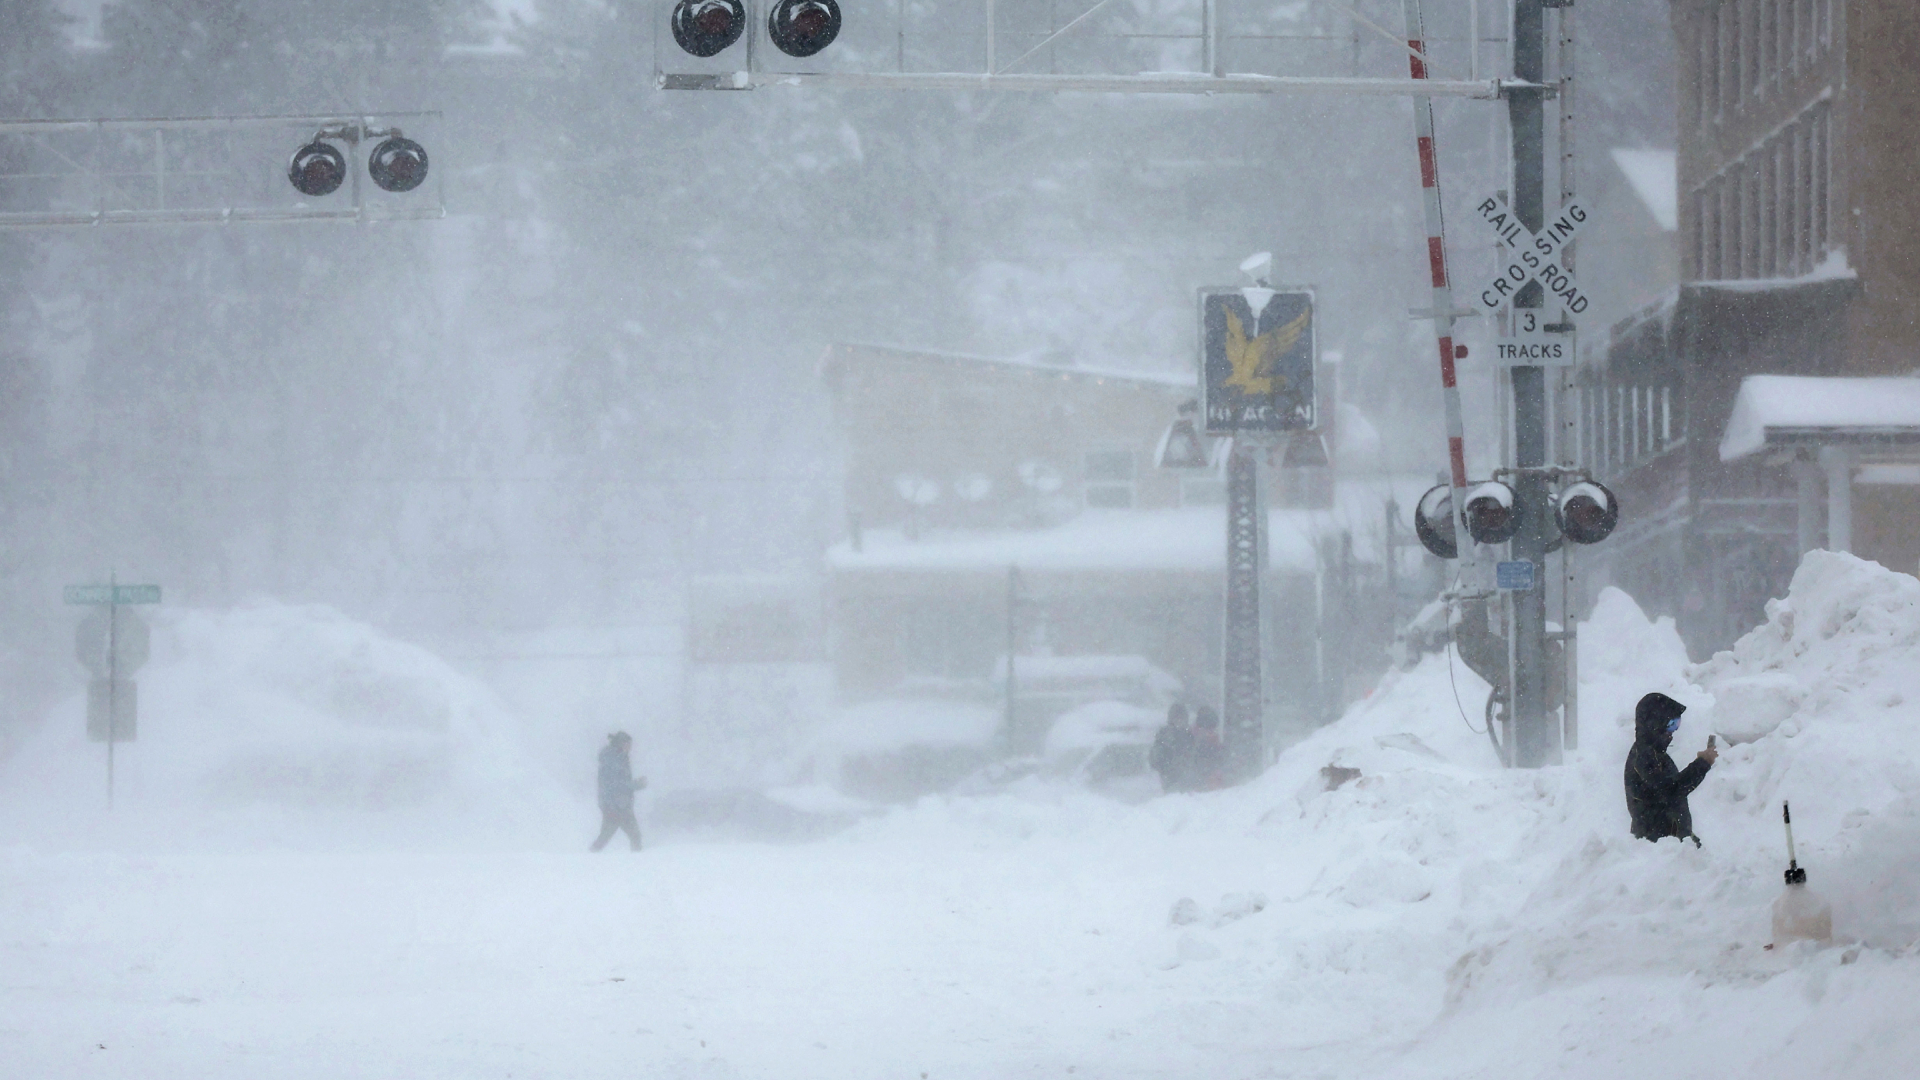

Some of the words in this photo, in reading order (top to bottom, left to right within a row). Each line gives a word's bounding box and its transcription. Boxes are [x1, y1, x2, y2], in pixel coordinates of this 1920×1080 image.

[1477, 197, 1521, 248] RAIL
[1539, 263, 1589, 314] ROAD
[1481, 205, 1587, 308] CROSSING
[1497, 344, 1563, 359] TRACKS
[1523, 313, 1536, 332] 3
